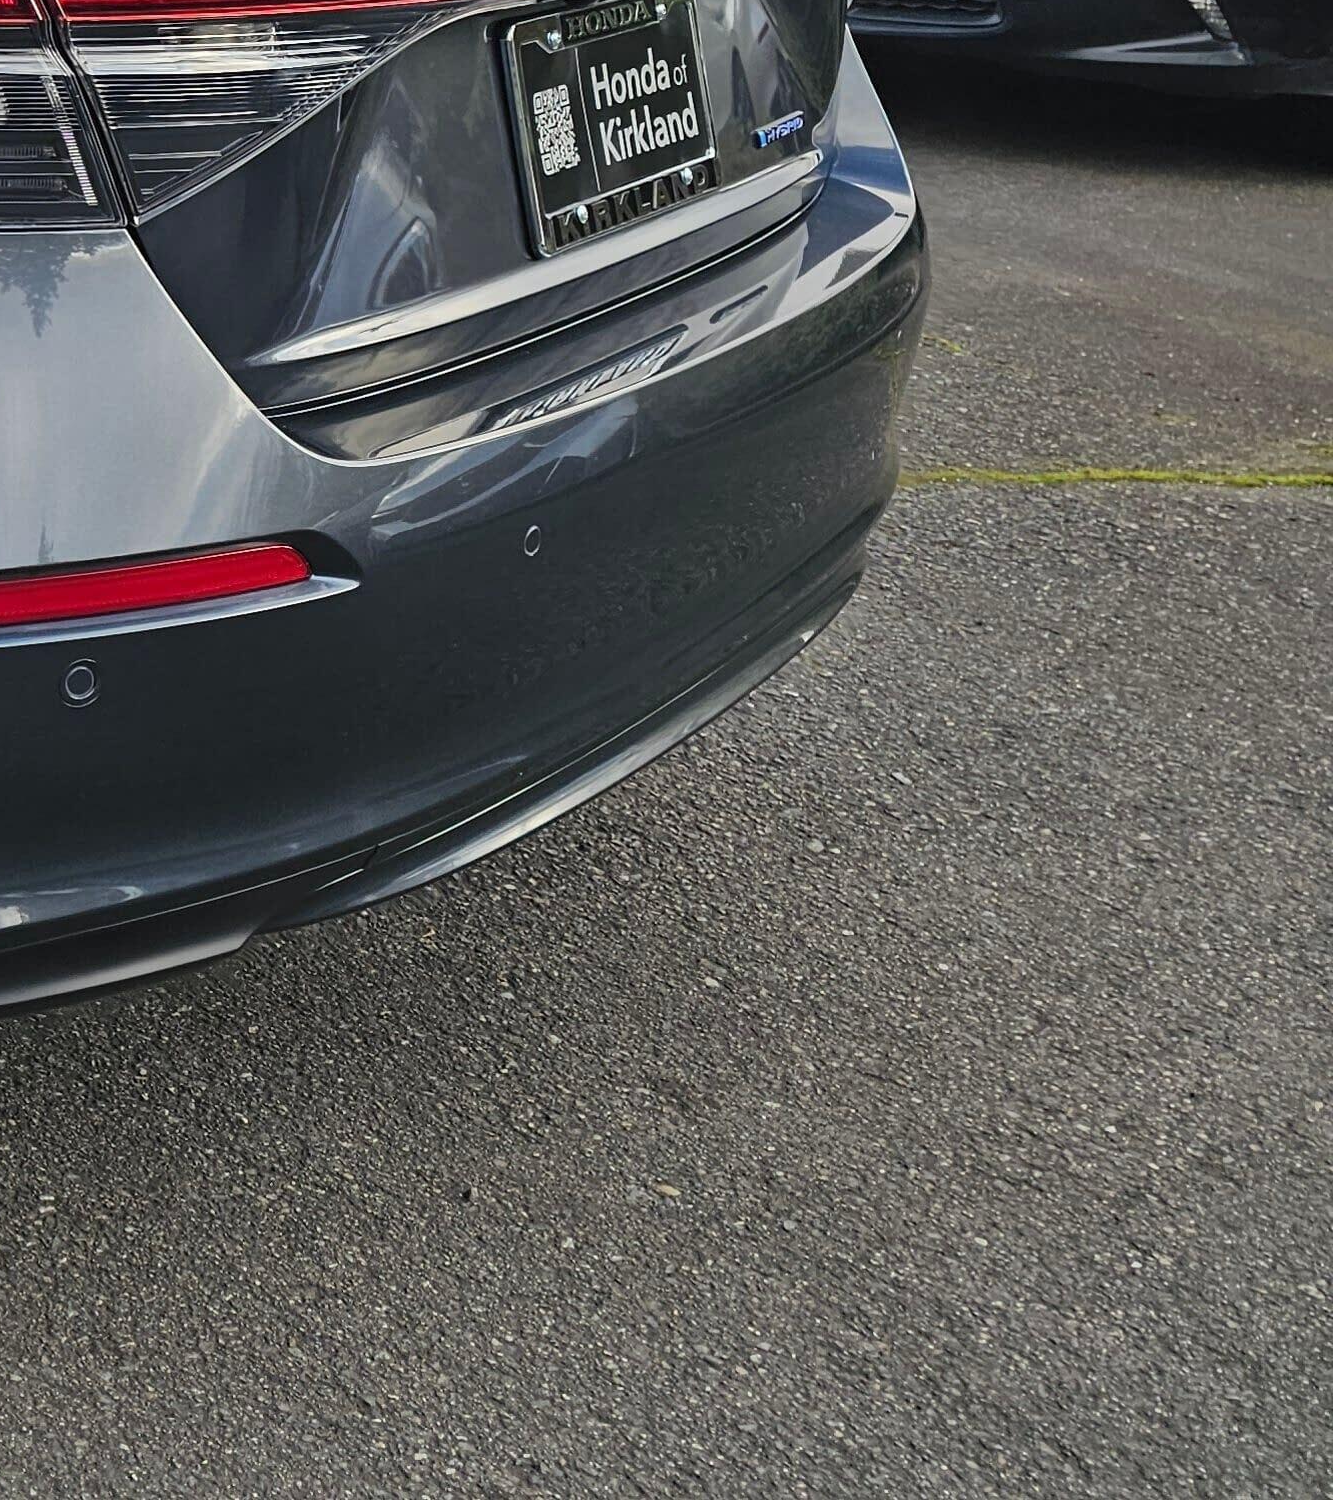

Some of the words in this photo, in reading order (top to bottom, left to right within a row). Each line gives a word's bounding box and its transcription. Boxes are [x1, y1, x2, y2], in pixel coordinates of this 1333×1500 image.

[566, 1, 651, 42] HONDA
[590, 47, 671, 110] Honda
[673, 53, 689, 86] of
[598, 91, 700, 166] Kirkland
